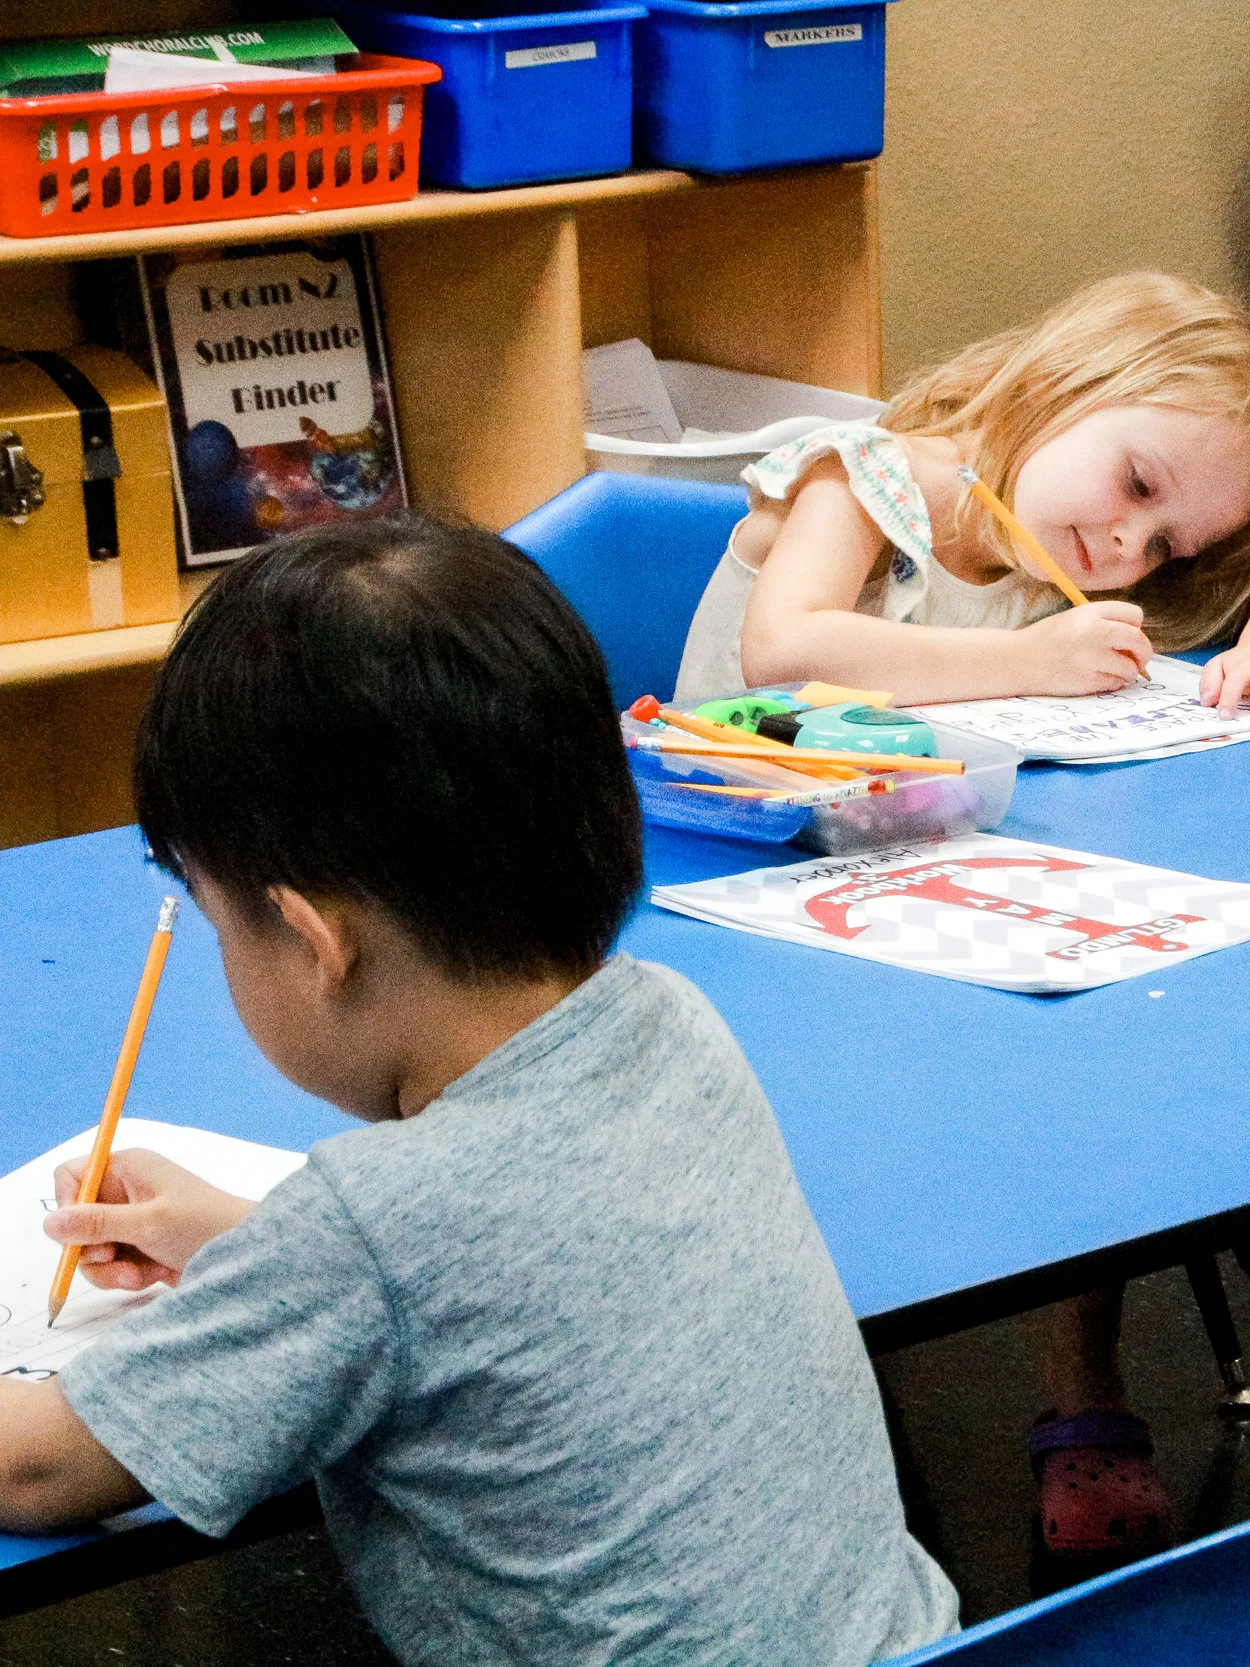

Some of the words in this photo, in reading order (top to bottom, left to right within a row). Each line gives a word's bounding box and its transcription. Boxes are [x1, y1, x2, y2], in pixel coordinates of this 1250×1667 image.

[774, 27, 856, 44] MARKERS
[198, 281, 292, 313] Room
[195, 323, 361, 367] Substitute
[231, 379, 341, 414] Binder
[818, 863, 975, 905] Workbook
